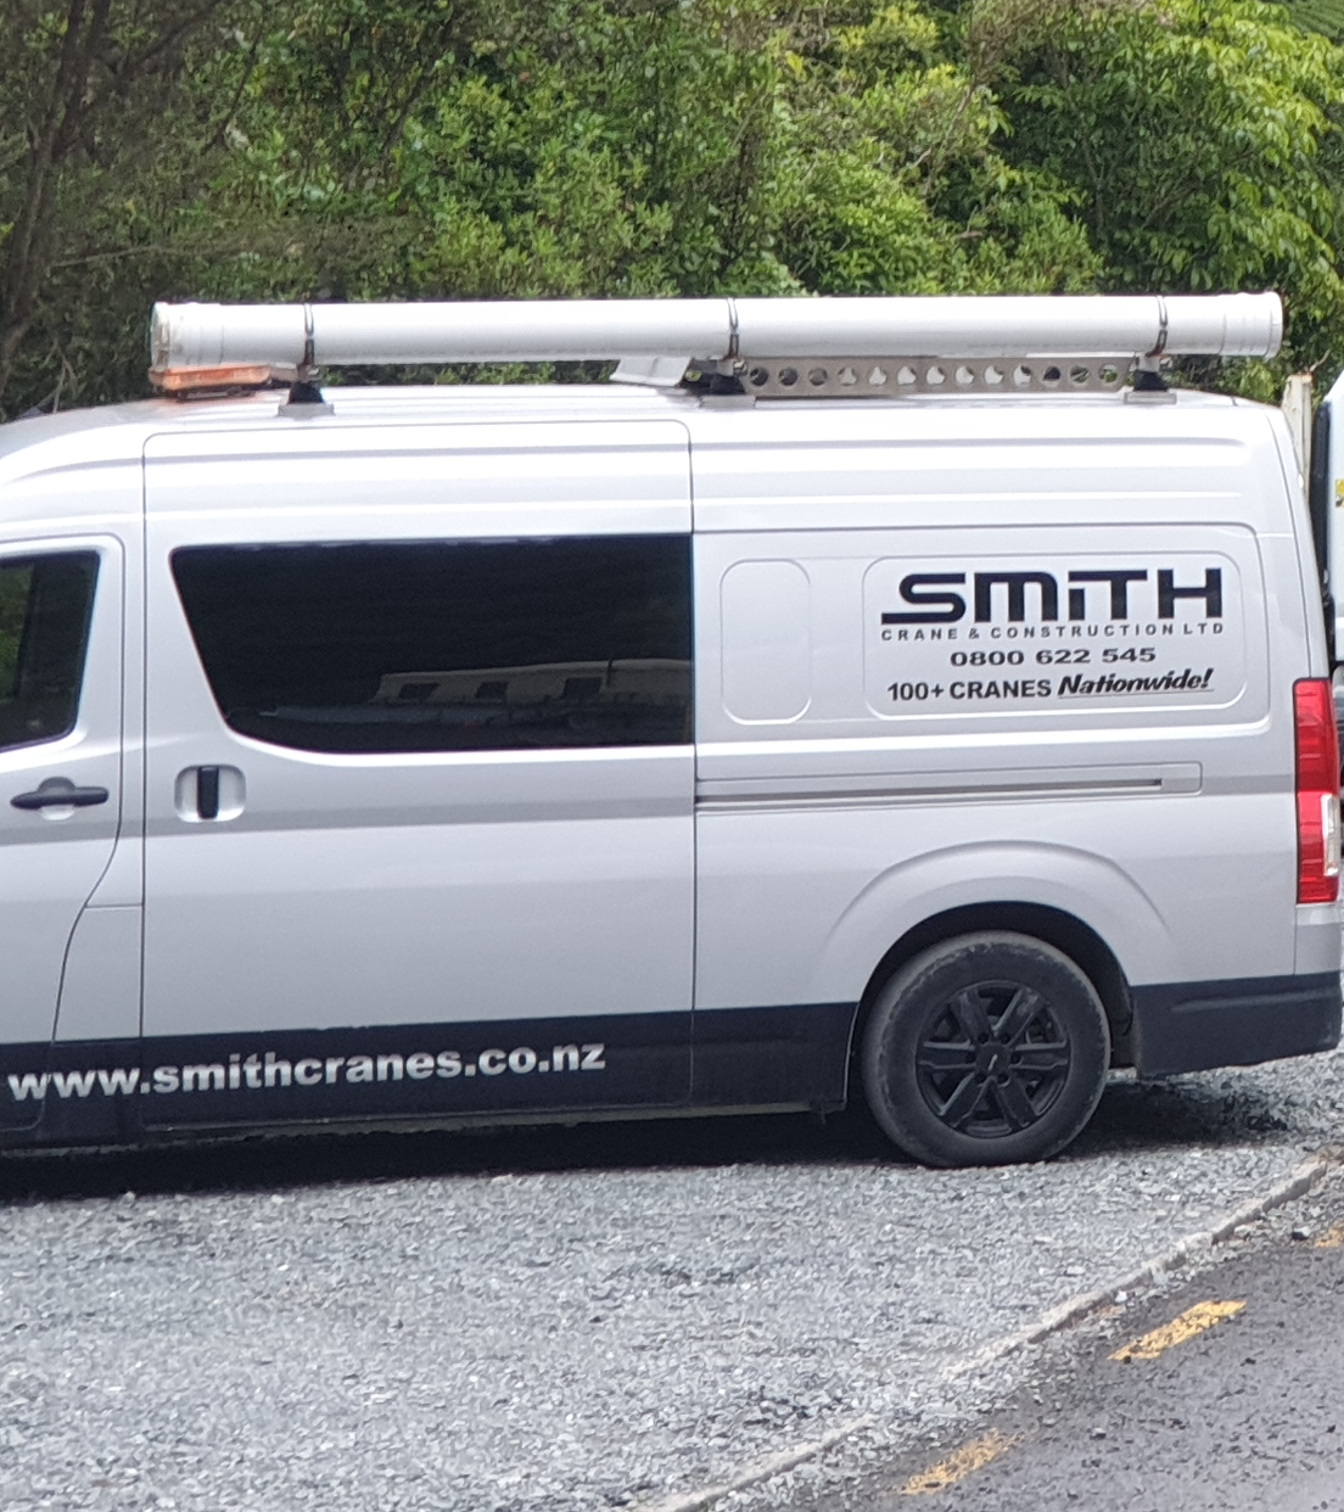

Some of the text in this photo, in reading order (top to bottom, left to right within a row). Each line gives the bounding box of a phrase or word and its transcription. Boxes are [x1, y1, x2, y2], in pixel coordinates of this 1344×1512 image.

[881, 568, 1223, 625] SMITH
[881, 622, 1224, 642] CRANE & CONSTRUCTION LTD
[949, 647, 1157, 667] 0800 622 545
[887, 667, 1215, 702] 100+ CRANES Nationwide!
[7, 1043, 606, 1101] www.smithcranes.co.nz
